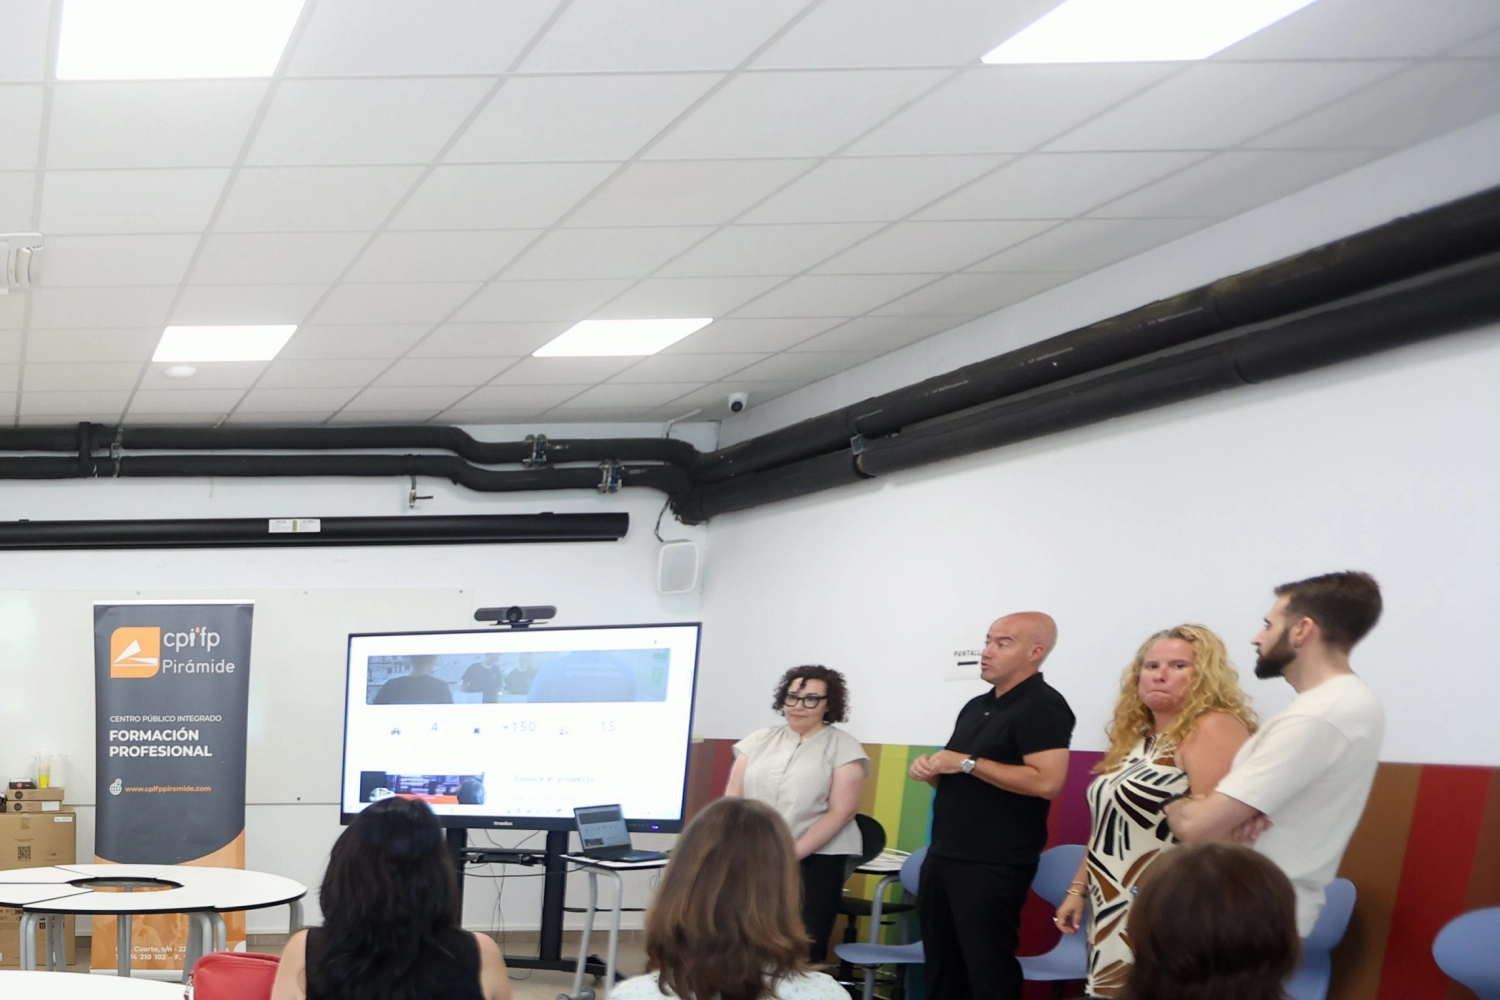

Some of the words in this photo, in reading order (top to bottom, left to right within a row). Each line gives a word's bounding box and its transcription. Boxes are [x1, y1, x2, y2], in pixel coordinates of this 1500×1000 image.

[162, 658, 235, 674] Pirámide
[109, 715, 141, 723] CENTRO
[142, 714, 176, 723] PÚBLICO
[177, 714, 222, 722] INTEGRADO
[503, 721, 537, 732] +150
[600, 720, 617, 732] 15
[109, 726, 199, 741] FORMACIÓN
[109, 745, 213, 757] PROFESIONAL
[135, 945, 160, 953] Cuarte,
